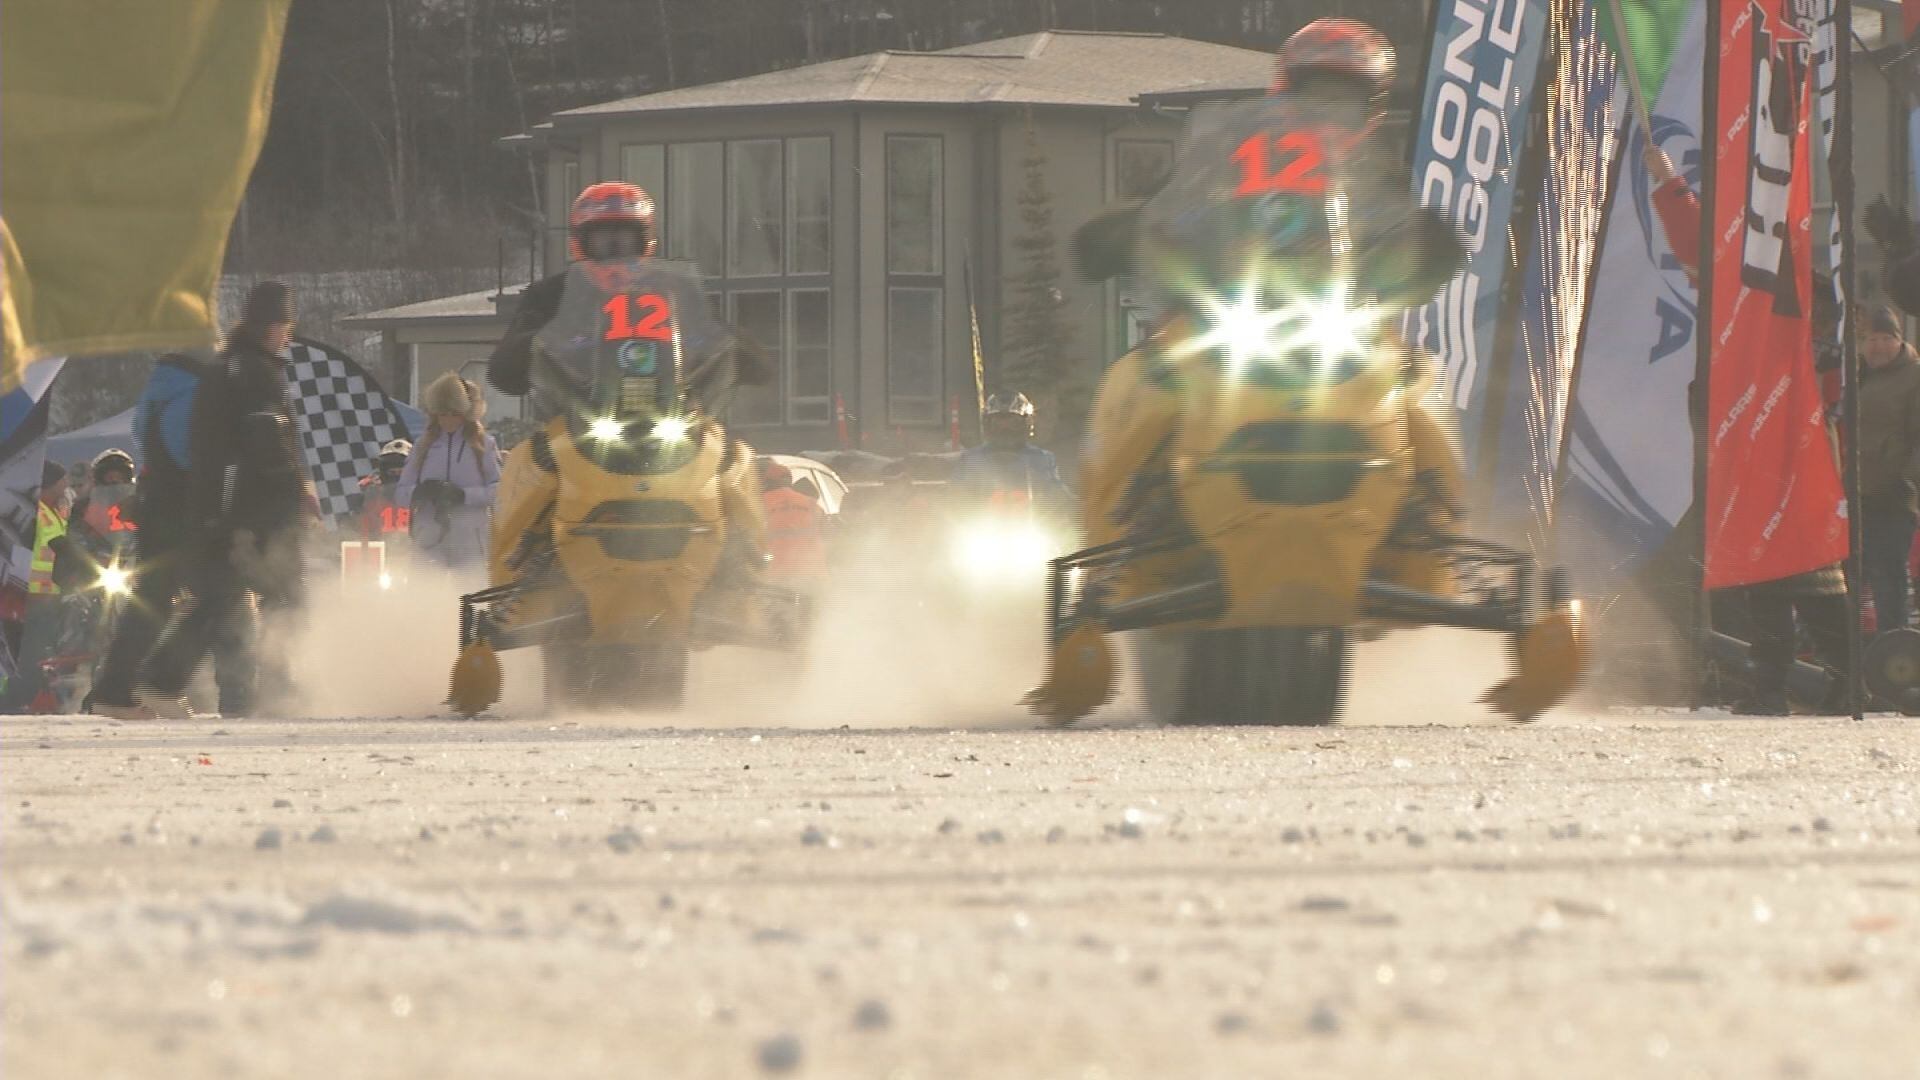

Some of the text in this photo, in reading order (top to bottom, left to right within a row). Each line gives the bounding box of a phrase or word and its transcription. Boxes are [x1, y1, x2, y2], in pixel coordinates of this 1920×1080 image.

[1229, 130, 1328, 198] 12
[1420, 0, 1488, 219] DON
[1456, 0, 1525, 254] GOLD
[602, 293, 672, 341] 12
